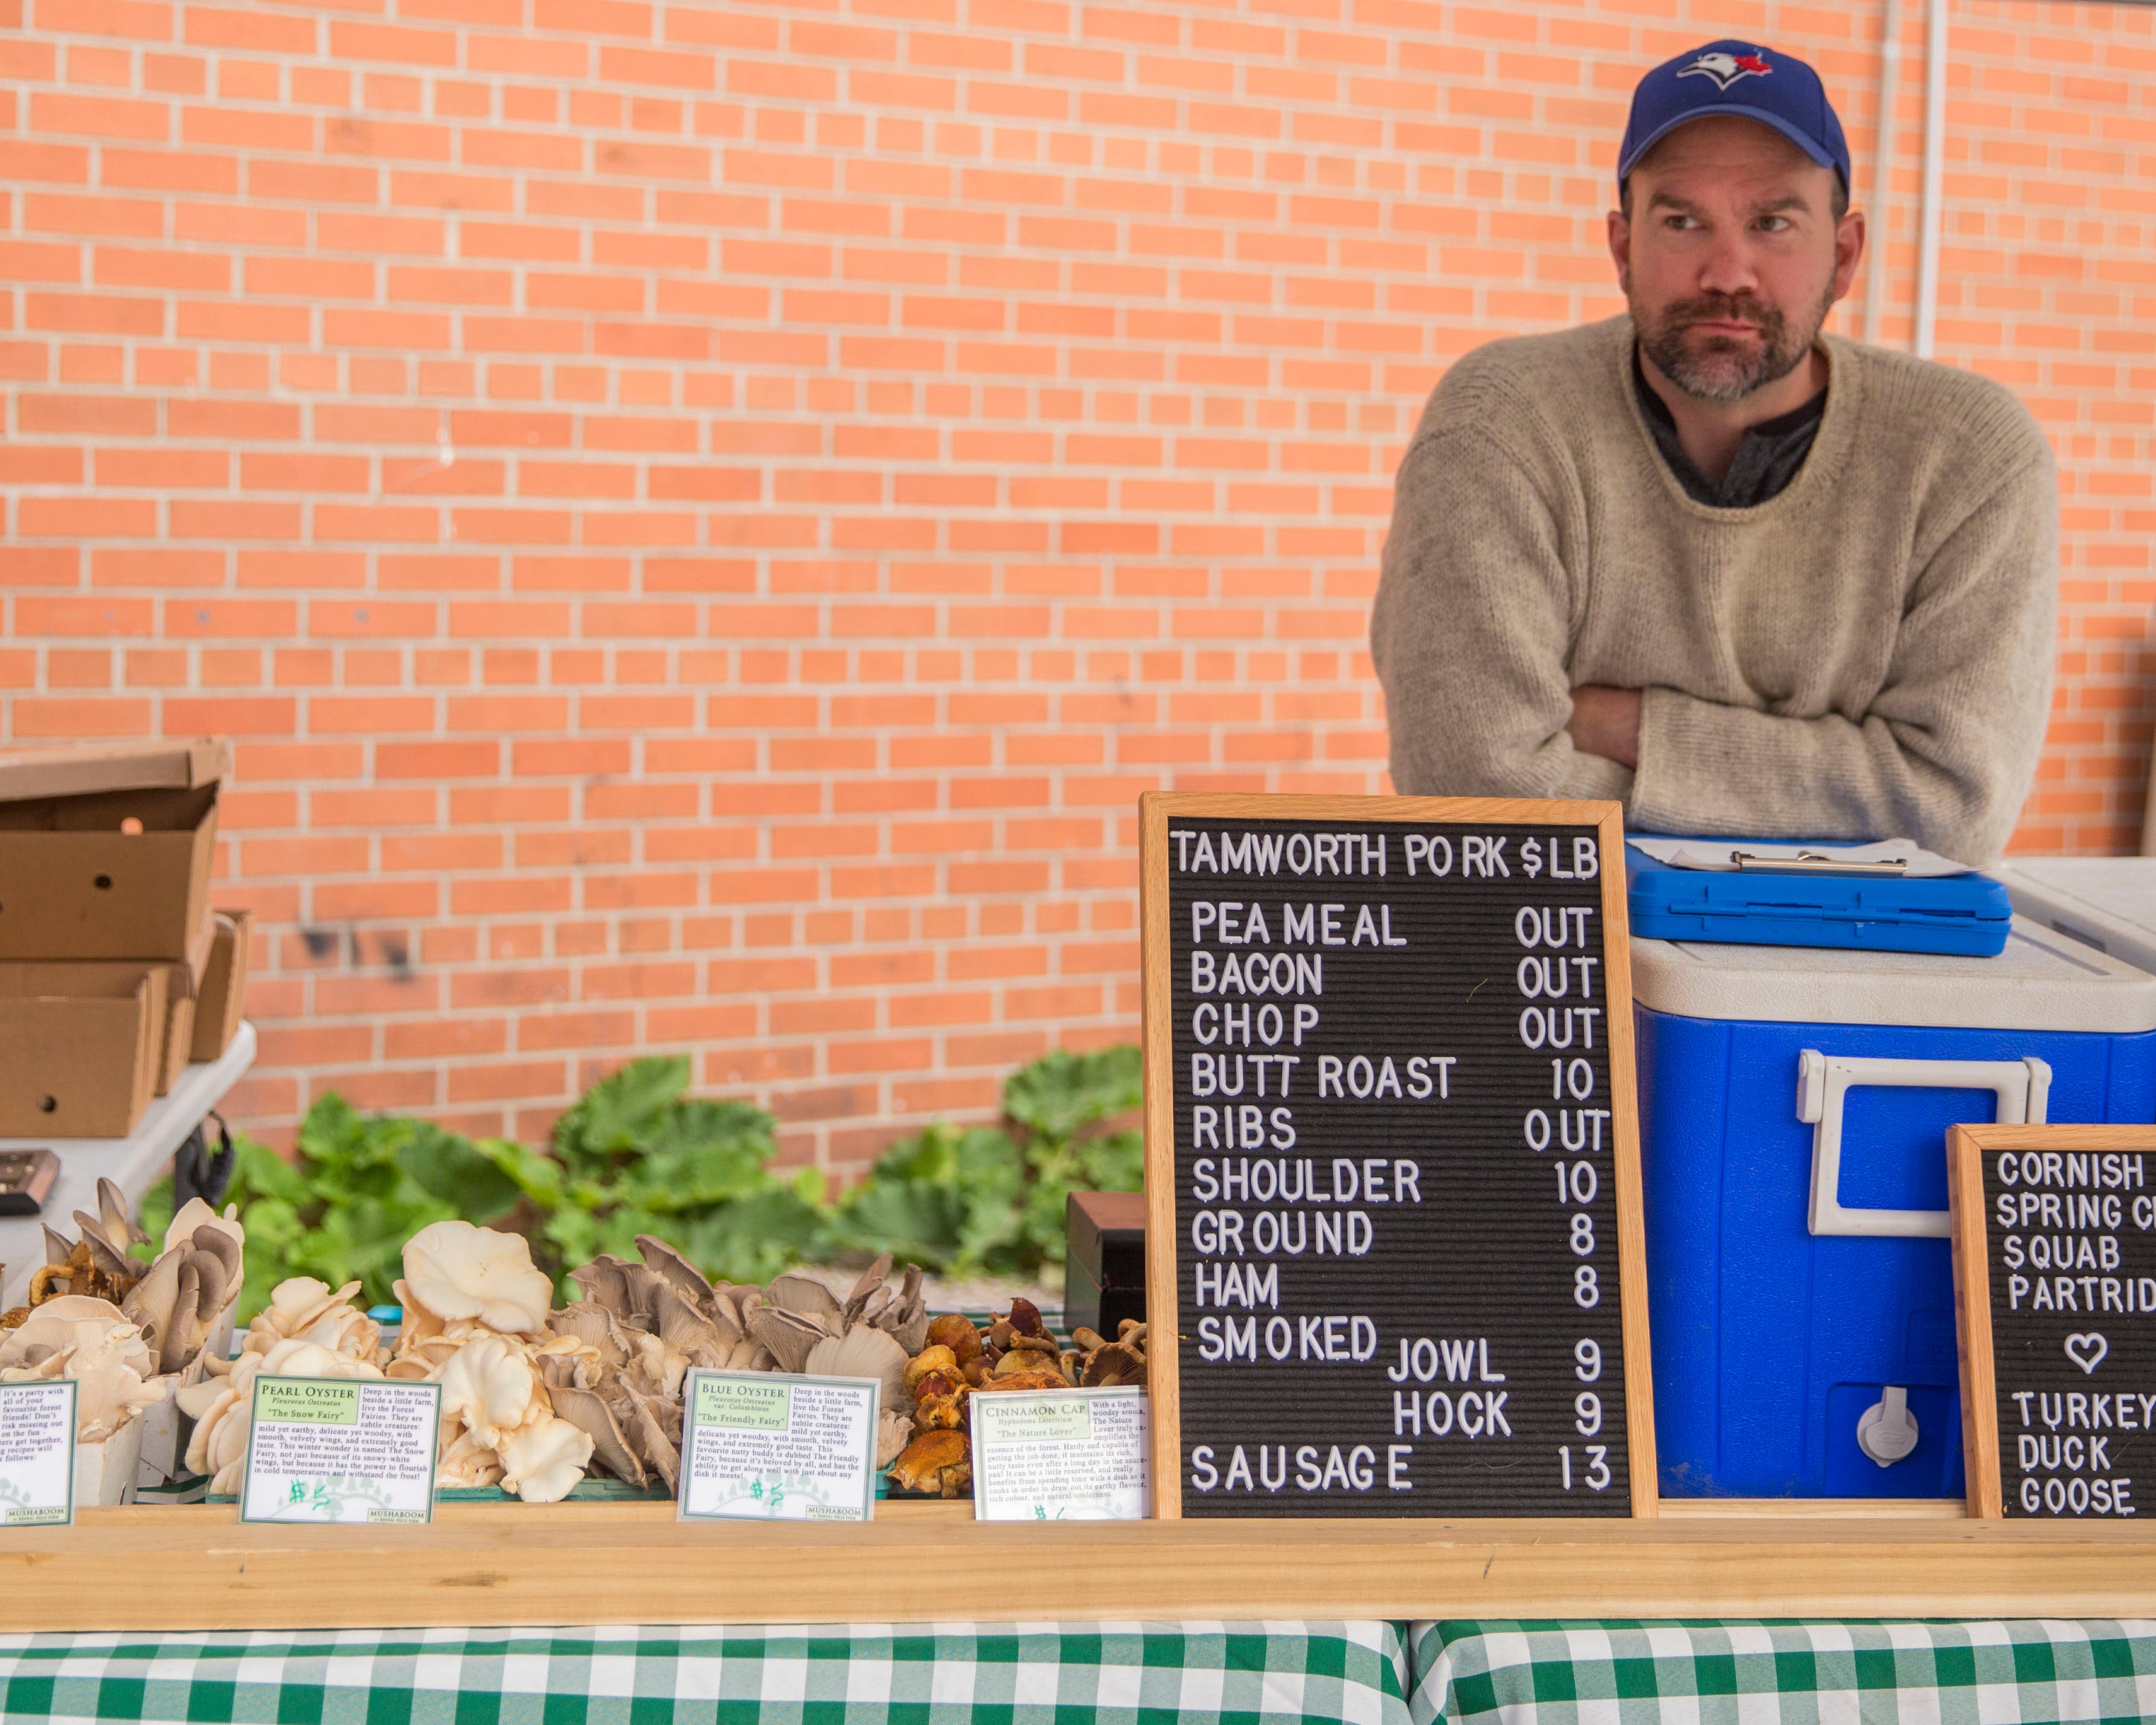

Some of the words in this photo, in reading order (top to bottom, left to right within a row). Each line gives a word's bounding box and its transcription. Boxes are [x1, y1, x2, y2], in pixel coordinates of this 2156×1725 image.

[1169, 830, 1386, 877] TAMWORTH
[1404, 834, 1510, 878] PORK
[1515, 906, 1593, 948] OUT
[1192, 951, 1322, 996] BACON
[1517, 956, 1598, 998] OUT
[1192, 1003, 1319, 1047] CHOP
[1519, 1006, 1600, 1049] OUT
[1192, 1053, 1300, 1098] BUTT
[1318, 1055, 1457, 1099] ROAST
[1551, 1058, 1594, 1101] 10
[1193, 1105, 1296, 1151] RIBS
[1524, 1108, 1611, 1152] OUT
[1193, 1157, 1421, 1203] SHOULDER
[1554, 1160, 1597, 1204] 10
[1998, 1152, 2143, 1190] CORNISH
[1997, 1192, 2122, 1230] SPRING
[2132, 1195, 2156, 1230] C
[1192, 1209, 1373, 1256] GROUND
[1570, 1213, 1594, 1256] 8
[2003, 1235, 2120, 1272] SQUAB
[1195, 1262, 1278, 1310] HAM
[1574, 1265, 1599, 1308] 8
[1198, 1315, 1377, 1363] SMOKED
[1387, 1337, 1506, 1383] JOWL
[1574, 1338, 1601, 1382] 9
[25, 1389, 44, 1397] party
[261, 1385, 300, 1396] PEARL
[306, 1387, 355, 1398] OYSTER
[364, 1389, 382, 1397] Deep
[414, 1398, 434, 1407] farm,
[702, 1384, 732, 1395] BLUE
[737, 1386, 784, 1398] OYSTER
[794, 1389, 812, 1397] Deep
[844, 1399, 862, 1407] farm,
[19, 1421, 48, 1429] missing
[291, 1410, 313, 1418] Snow
[720, 1415, 756, 1425] Friendly
[986, 1406, 1056, 1417] CINNAMON
[1062, 1404, 1085, 1414] CAP
[1393, 1390, 1512, 1438] HOCK
[1574, 1392, 1602, 1436] 9
[2011, 1391, 2156, 1431] TURKEY
[7, 1446, 34, 1454] recipes
[29, 1437, 62, 1445] together,
[258, 1434, 286, 1442] smooth,
[289, 1435, 316, 1444] velvety
[319, 1436, 342, 1445] wings,
[361, 1438, 397, 1447] extremely
[291, 1427, 316, 1436] earthy,
[364, 1429, 393, 1438] woodsy,
[1191, 1444, 1413, 1492] SAUSAGE
[1558, 1445, 1611, 1491] 13
[2018, 1434, 2111, 1472] DUCK
[8, 1508, 64, 1517] MUSHABOOM
[809, 1508, 861, 1516] MUSHABOOM
[2021, 1477, 2135, 1517] GOOSE
